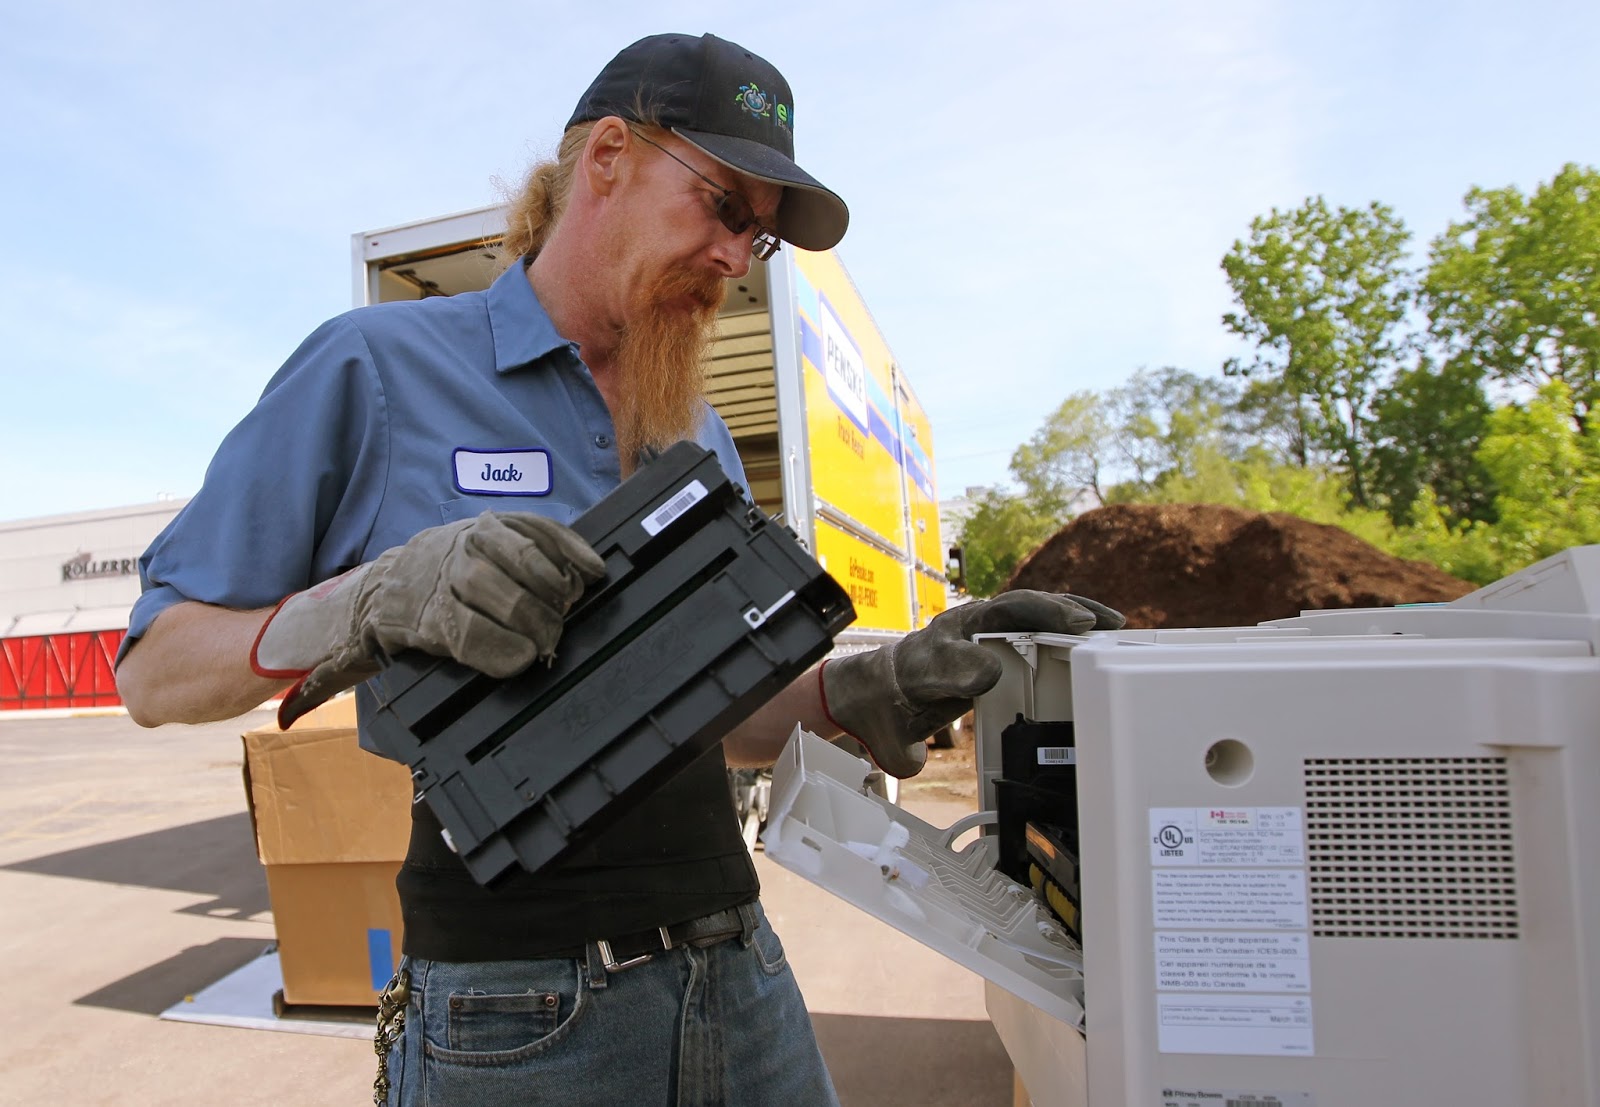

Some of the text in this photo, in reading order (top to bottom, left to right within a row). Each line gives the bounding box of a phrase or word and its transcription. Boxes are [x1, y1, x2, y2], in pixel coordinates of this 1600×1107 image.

[827, 333, 863, 403] PENSKE
[837, 415, 865, 460] Truck Rental
[481, 463, 523, 482] Jack
[62, 557, 138, 581] ROLLERRI
[1164, 830, 1178, 844] UL
[1211, 936, 1236, 944] digital
[1159, 960, 1174, 968] Cet
[1176, 961, 1209, 969] appareil
